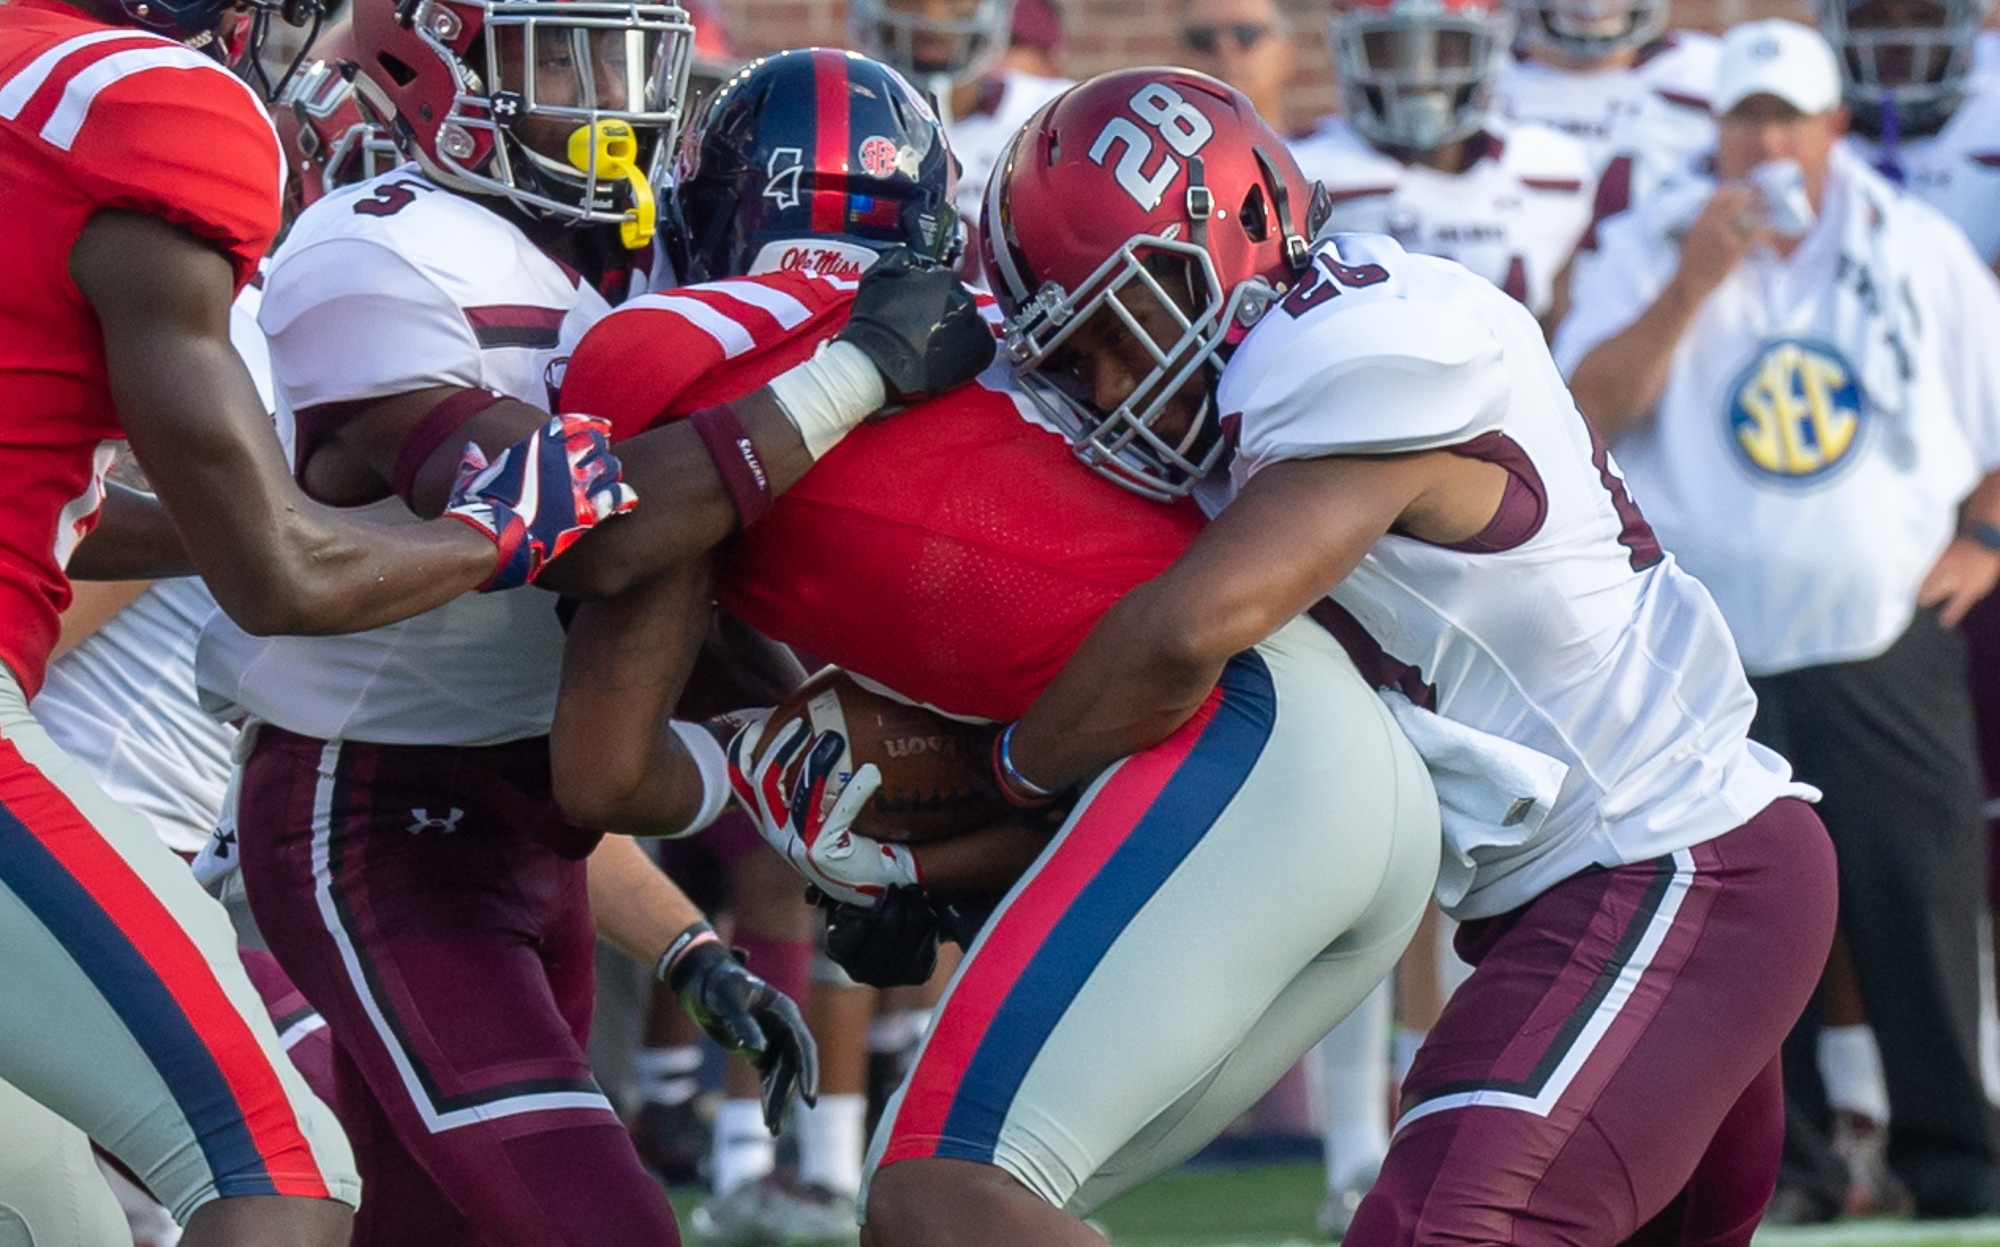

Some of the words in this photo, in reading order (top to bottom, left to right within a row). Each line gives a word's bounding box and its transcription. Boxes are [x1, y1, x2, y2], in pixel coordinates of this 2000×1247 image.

[1088, 82, 1214, 214] 28
[352, 179, 435, 218] 5
[813, 248, 860, 276] Miss
[1738, 344, 1860, 475] SEC
